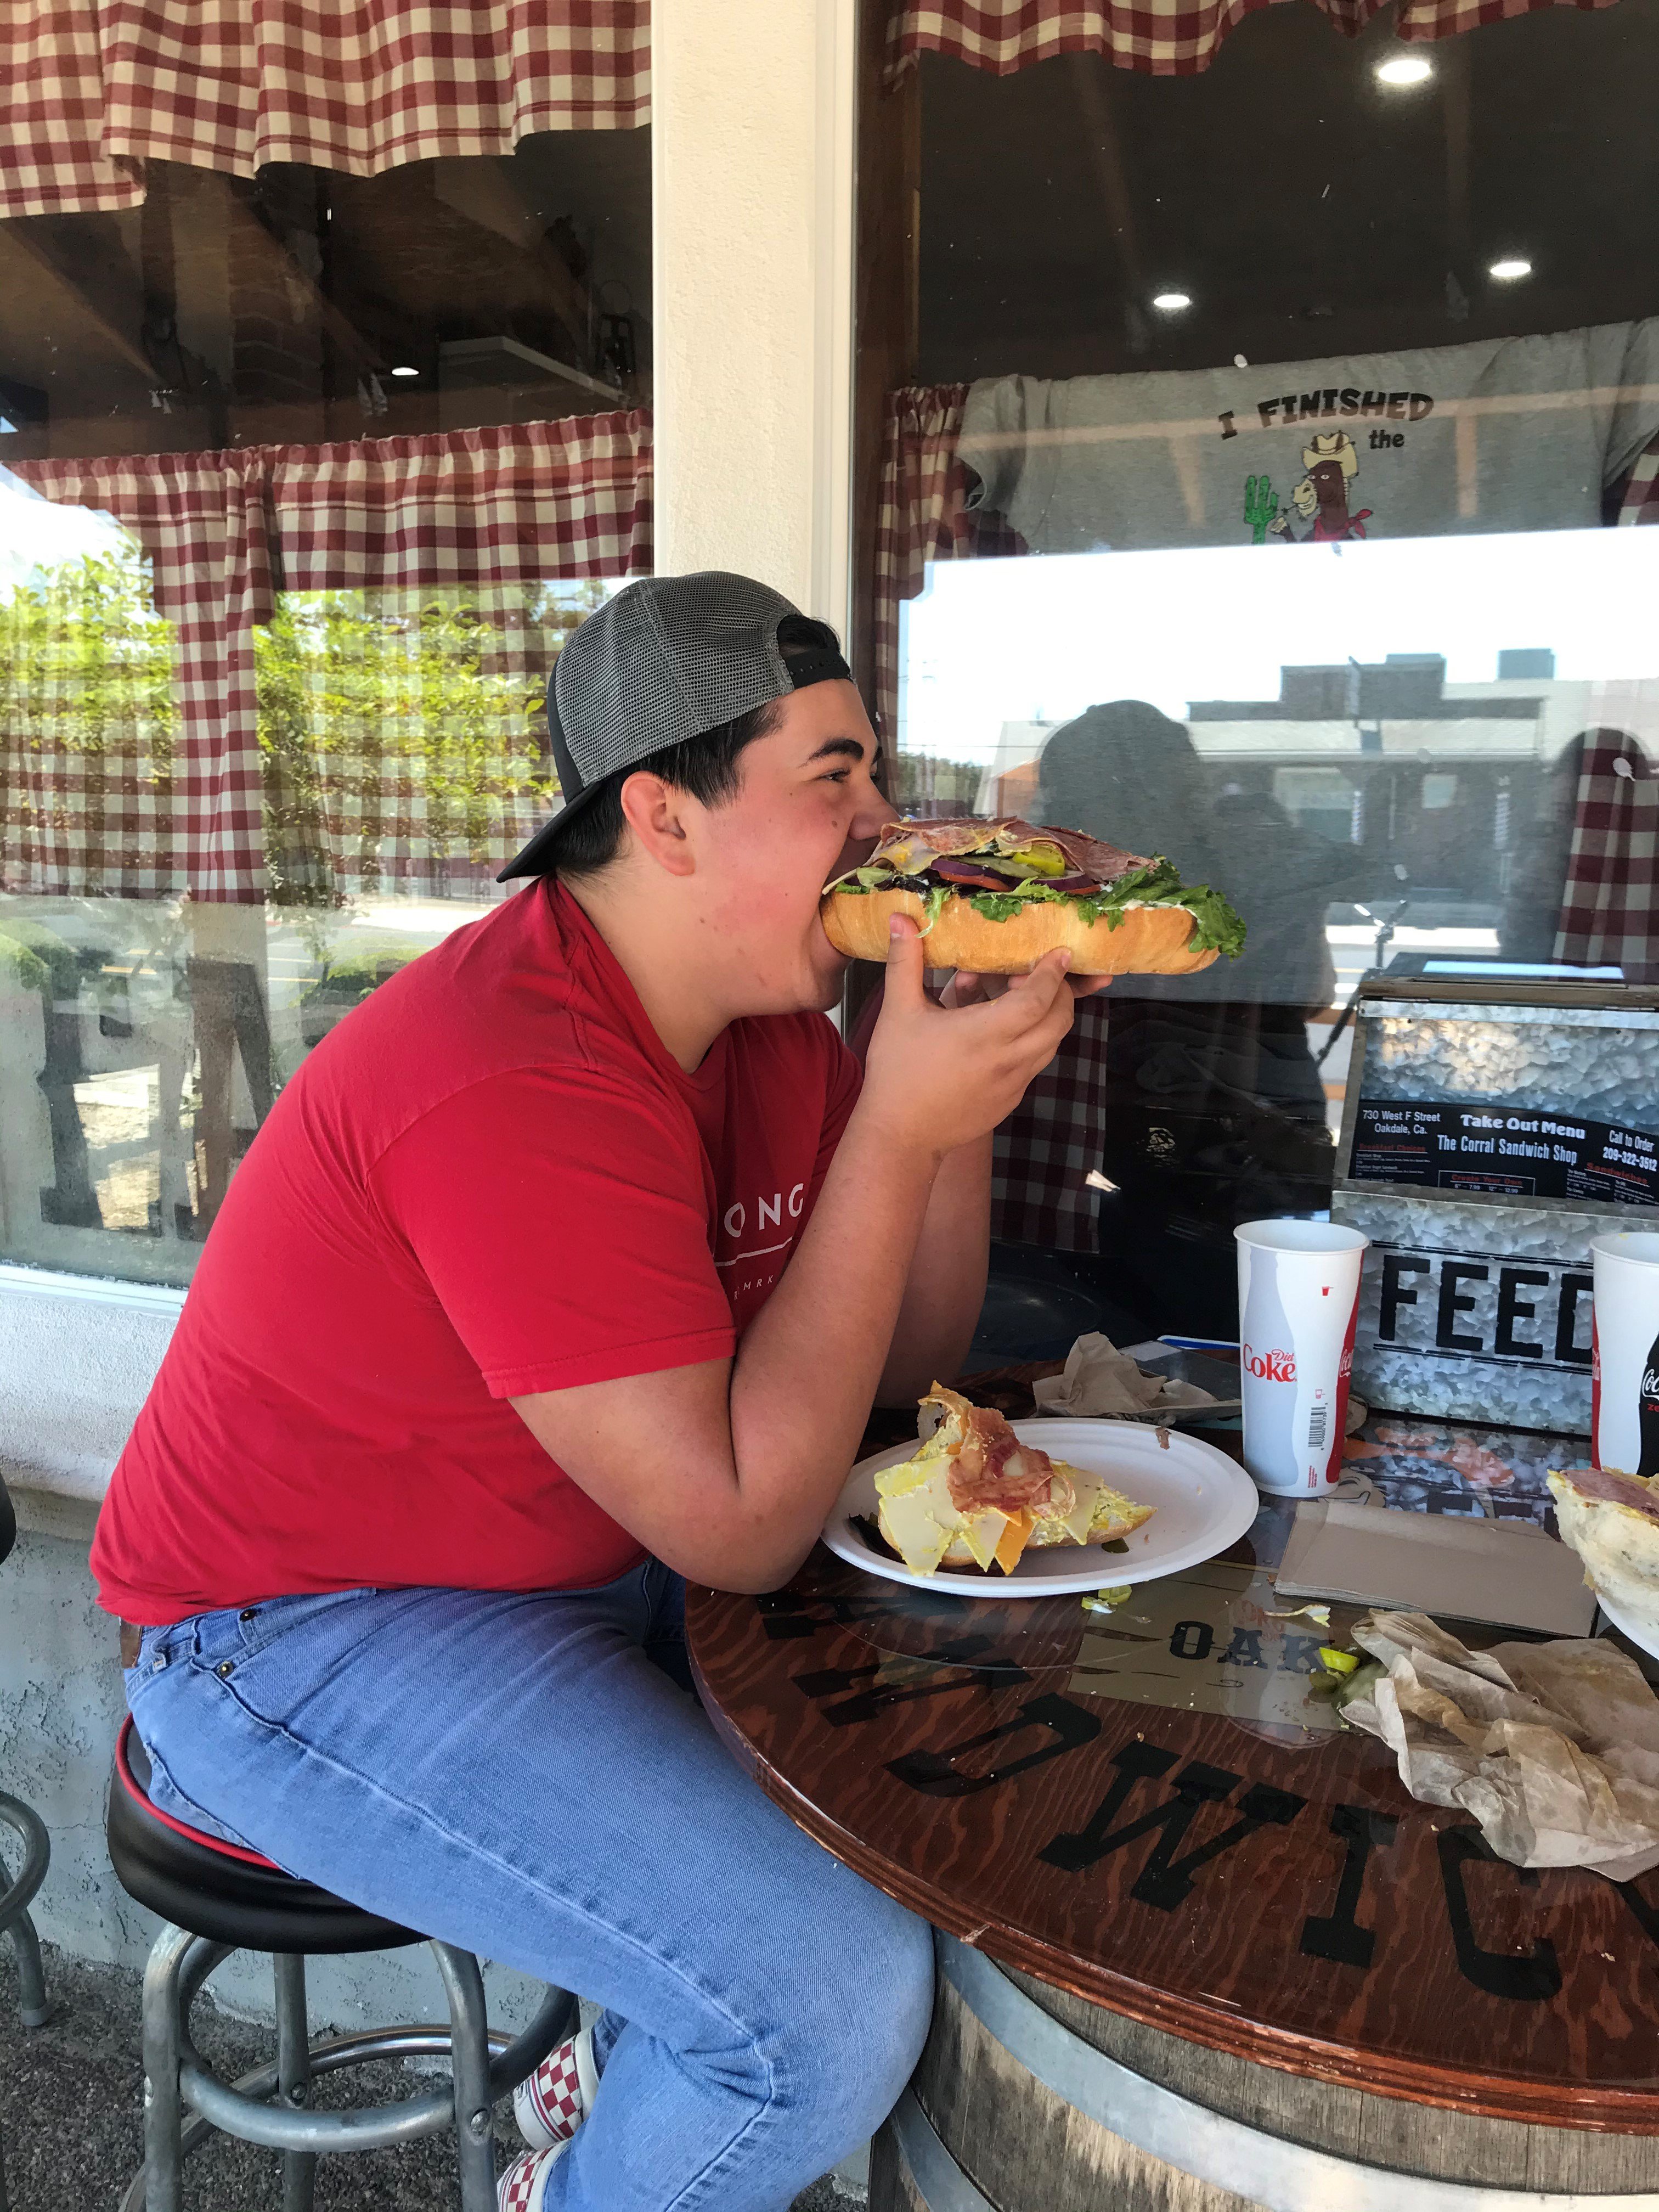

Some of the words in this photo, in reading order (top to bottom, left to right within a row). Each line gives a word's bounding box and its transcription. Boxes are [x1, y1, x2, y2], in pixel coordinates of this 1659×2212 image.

[1217, 410, 1238, 440] I
[1257, 388, 1434, 427] FINISHED
[1369, 429, 1405, 449] the
[1362, 1110, 1379, 1120] 730
[1381, 1110, 1403, 1121] West
[1406, 1111, 1412, 1121] F
[1414, 1111, 1441, 1122] Street
[1460, 1114, 1503, 1129] Take
[1506, 1117, 1539, 1132] Out
[1541, 1121, 1586, 1139] Menu
[1374, 1123, 1411, 1135] Oakdale,
[1413, 1124, 1428, 1134] Ca.
[1437, 1134, 1457, 1151] The
[1461, 1135, 1494, 1153] Corral
[1498, 1138, 1549, 1160] Sandwich
[1553, 1144, 1578, 1166] Shop
[1609, 1130, 1623, 1145] Call
[1625, 1134, 1633, 1147] to
[1634, 1136, 1655, 1152] Order
[1602, 1146, 1657, 1172] 209-322-3512
[1243, 1343, 1296, 1382] Coke
[1271, 1348, 1295, 1362] Diet
